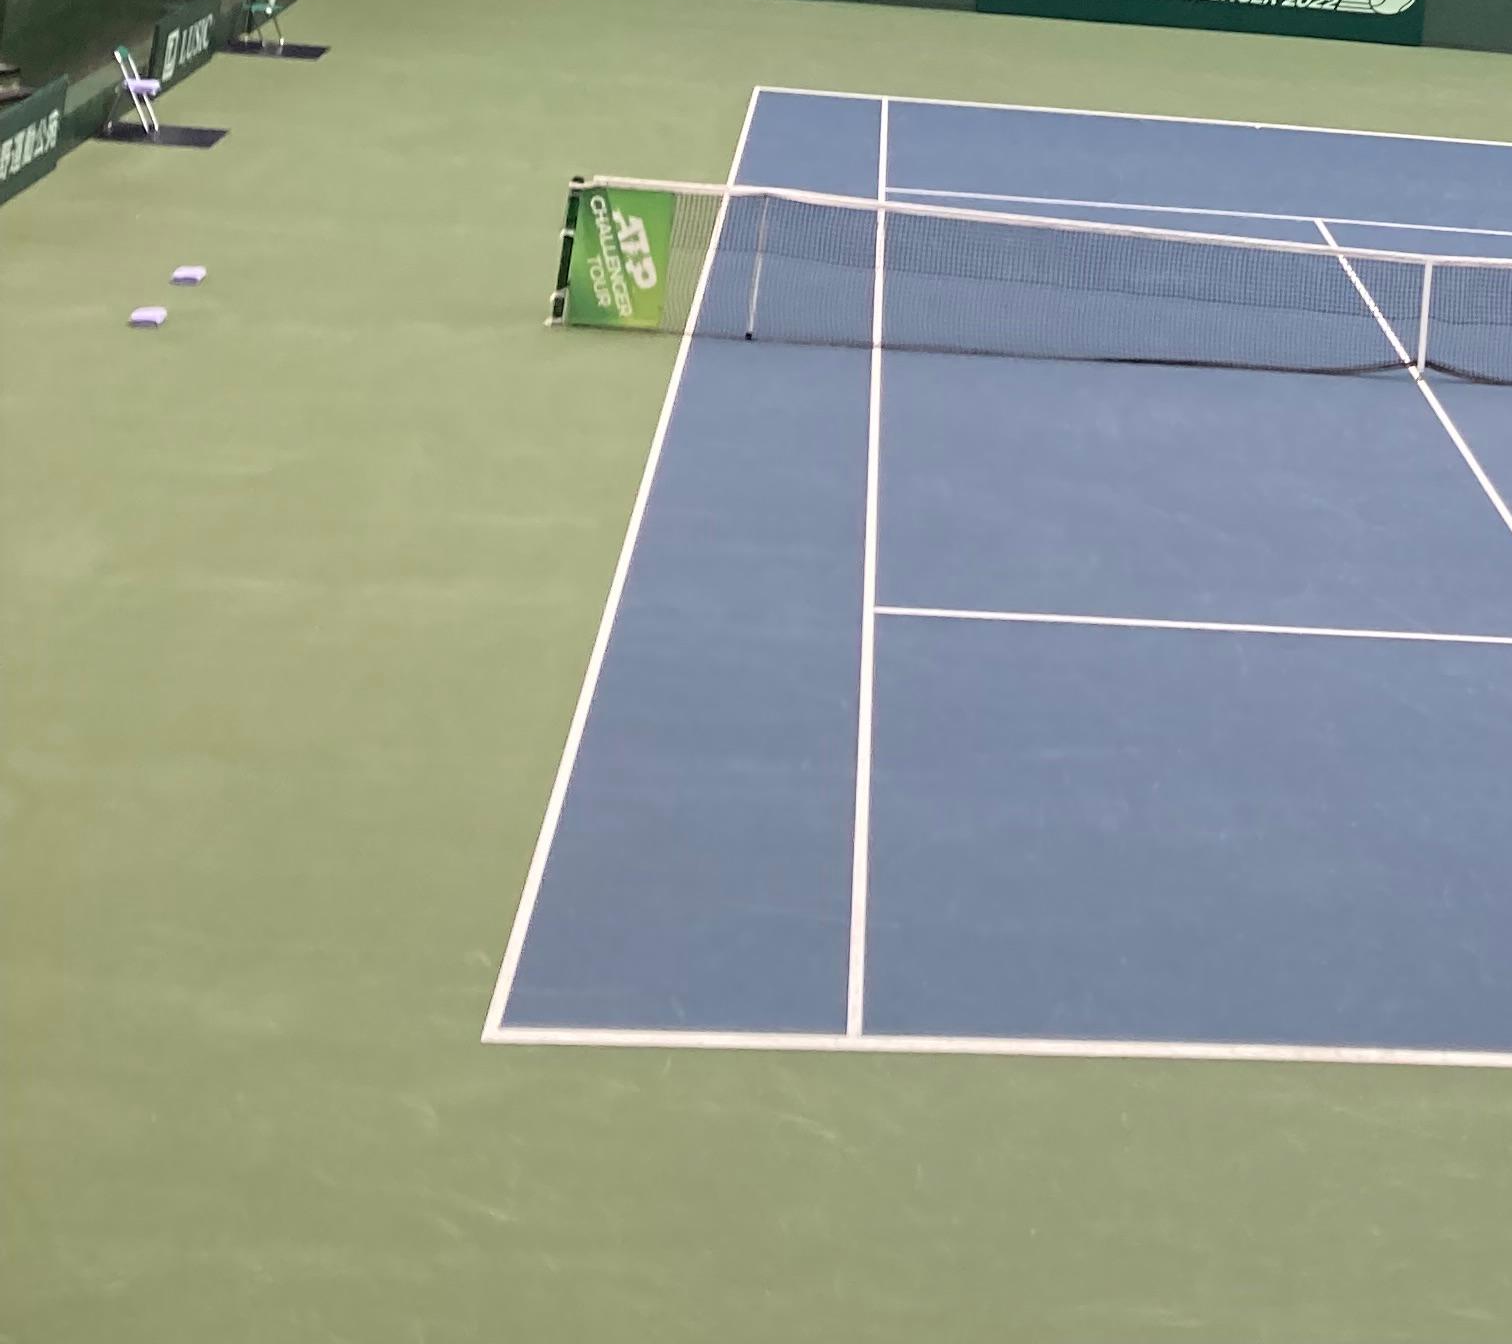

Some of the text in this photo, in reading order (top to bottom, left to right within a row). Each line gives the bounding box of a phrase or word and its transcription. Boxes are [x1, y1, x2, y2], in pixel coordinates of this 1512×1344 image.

[587, 255, 611, 307] TOUR
[590, 195, 632, 316] CHALLENGER
[612, 209, 657, 289] ATP
